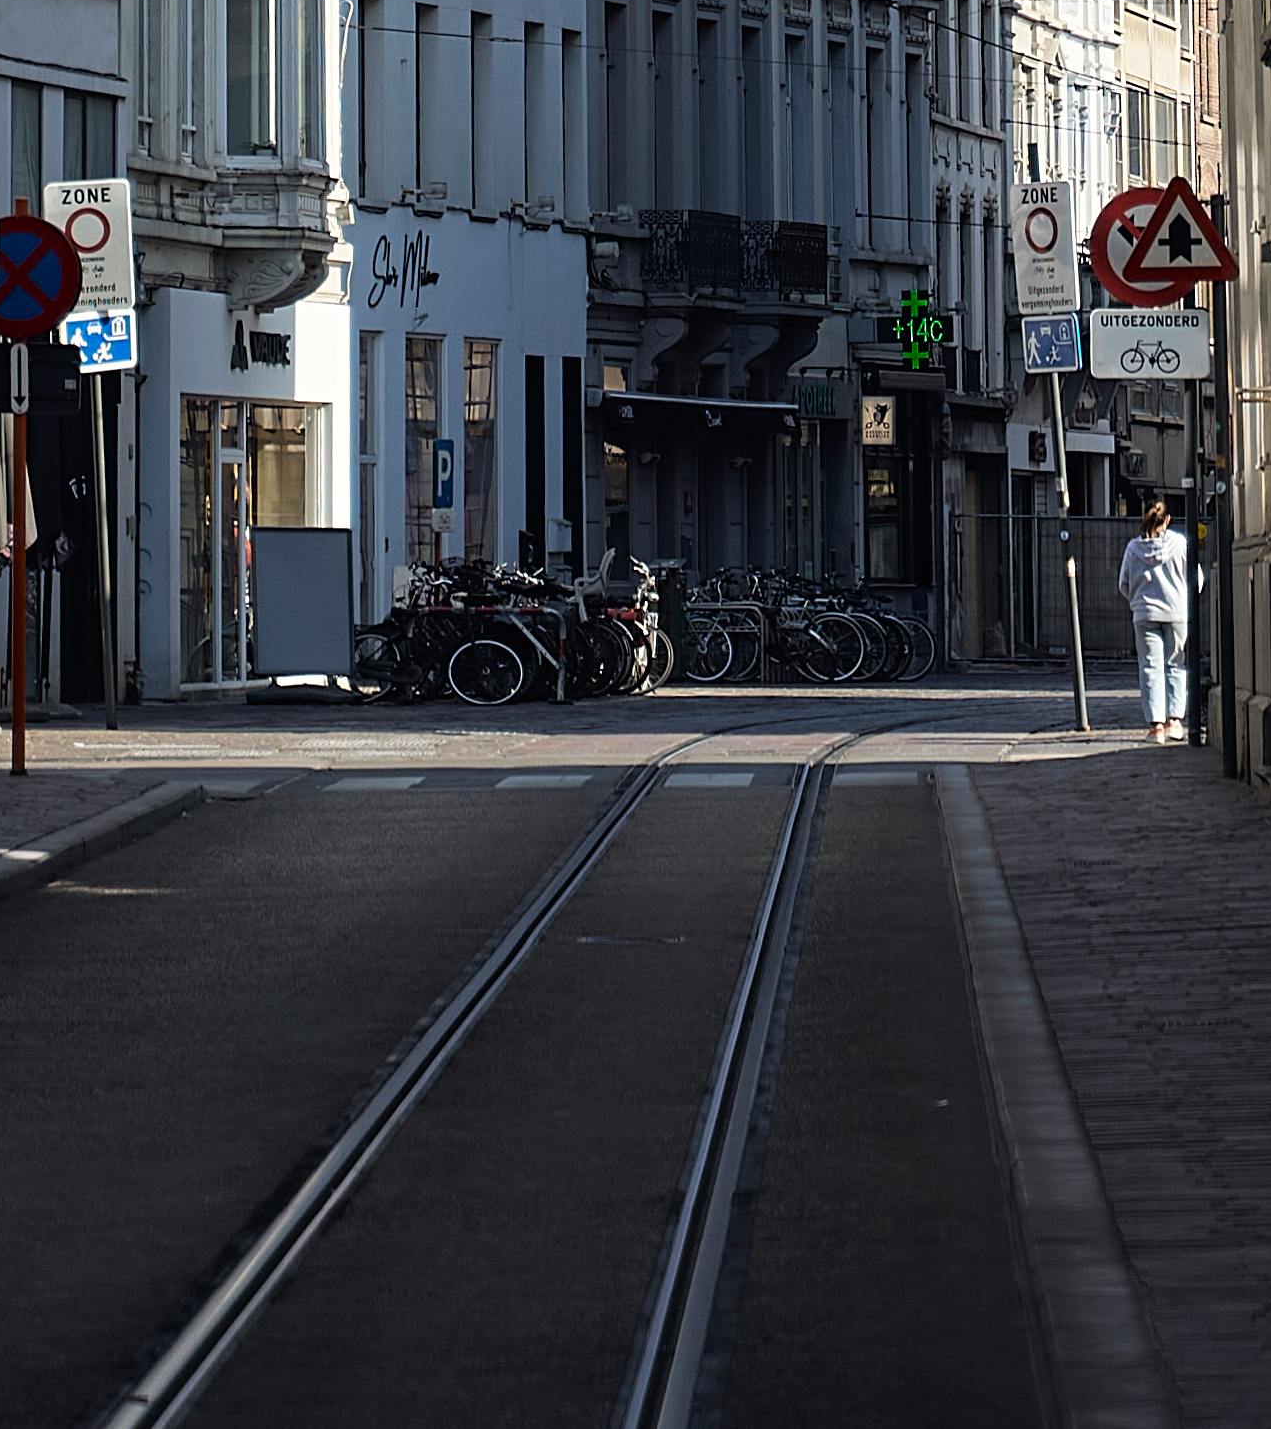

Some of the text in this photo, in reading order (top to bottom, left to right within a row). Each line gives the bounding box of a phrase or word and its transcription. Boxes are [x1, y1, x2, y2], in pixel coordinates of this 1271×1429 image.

[61, 187, 111, 205] ZONE
[1021, 187, 1059, 204] ZONE
[1100, 315, 1199, 328] UITGEZONDERD
[438, 449, 452, 497] P
